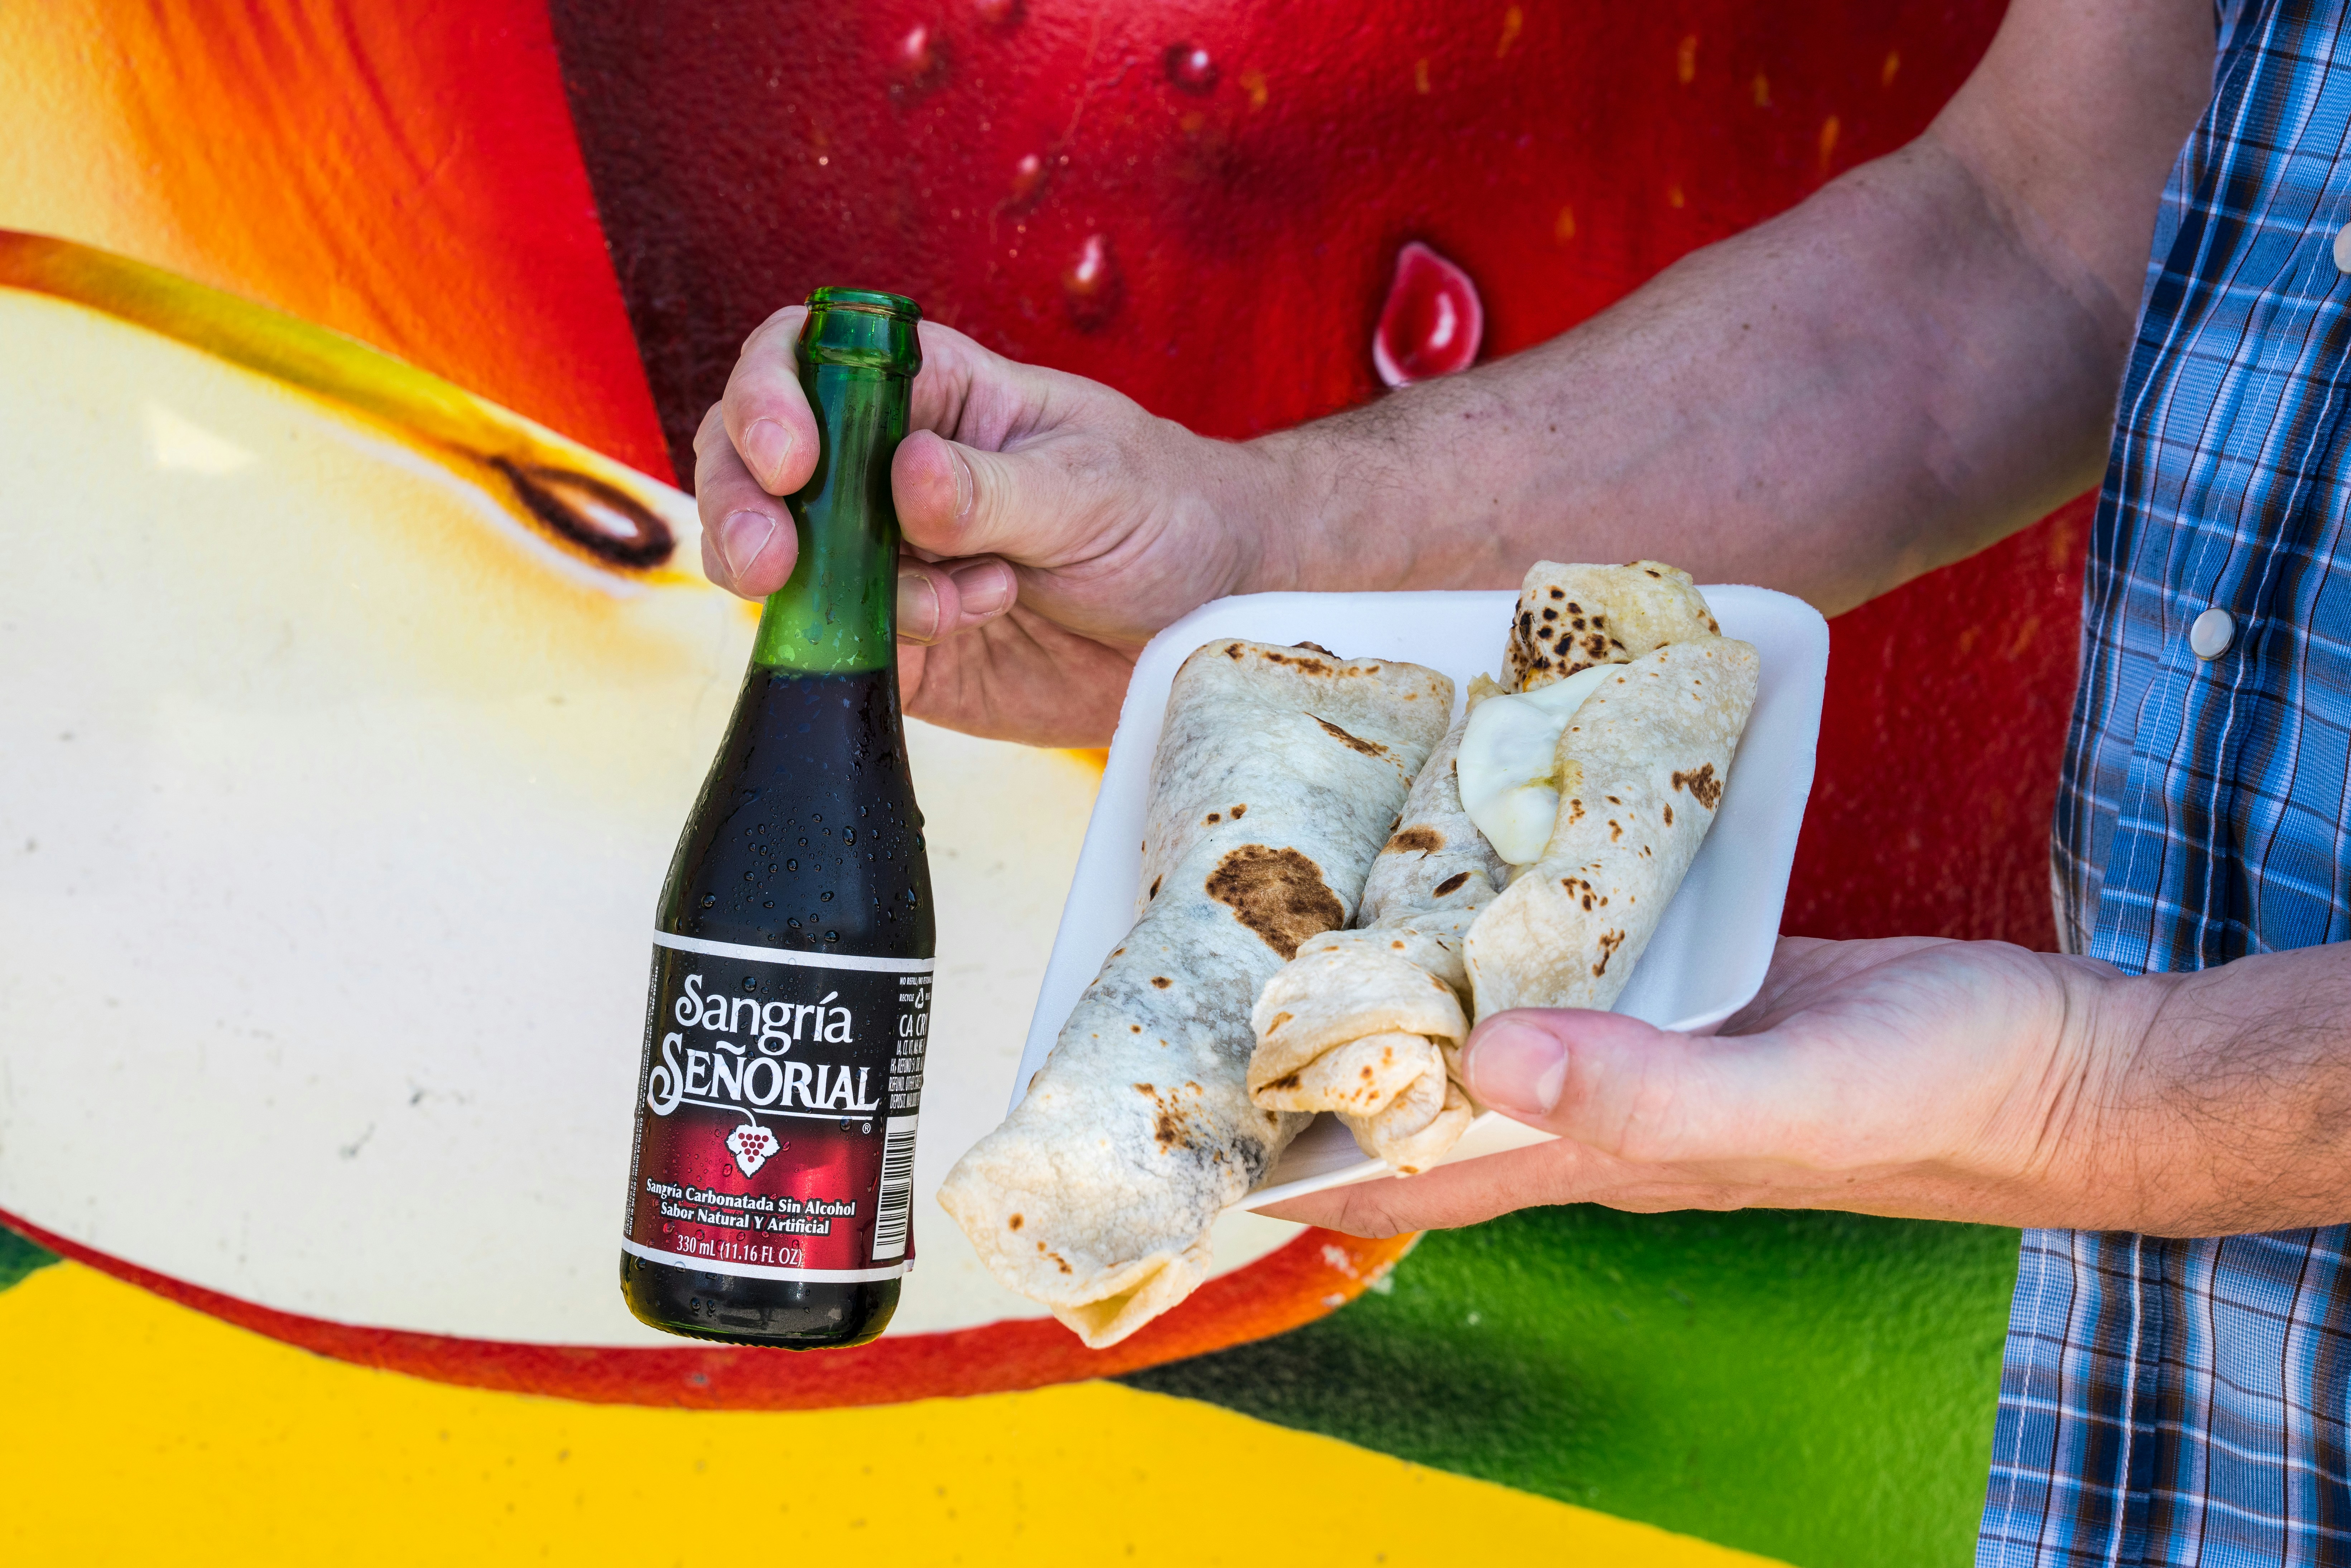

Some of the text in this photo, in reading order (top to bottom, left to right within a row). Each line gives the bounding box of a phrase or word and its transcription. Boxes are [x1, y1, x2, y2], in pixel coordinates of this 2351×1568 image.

[899, 977, 906, 985] NO
[675, 974, 853, 1055] Sangría
[899, 1014, 913, 1037] CA
[648, 1032, 880, 1116] SEÑORIAL
[897, 1058, 912, 1073] REFUND
[637, 1144, 641, 1153] EN
[630, 1181, 634, 1189] BY
[646, 1178, 855, 1216] Sangría Carbonatada Sin Alcohol
[661, 1202, 830, 1234] Sabor Natural Y Artificial
[677, 1235, 802, 1268] 330 mL (11.16 FL OZ)
